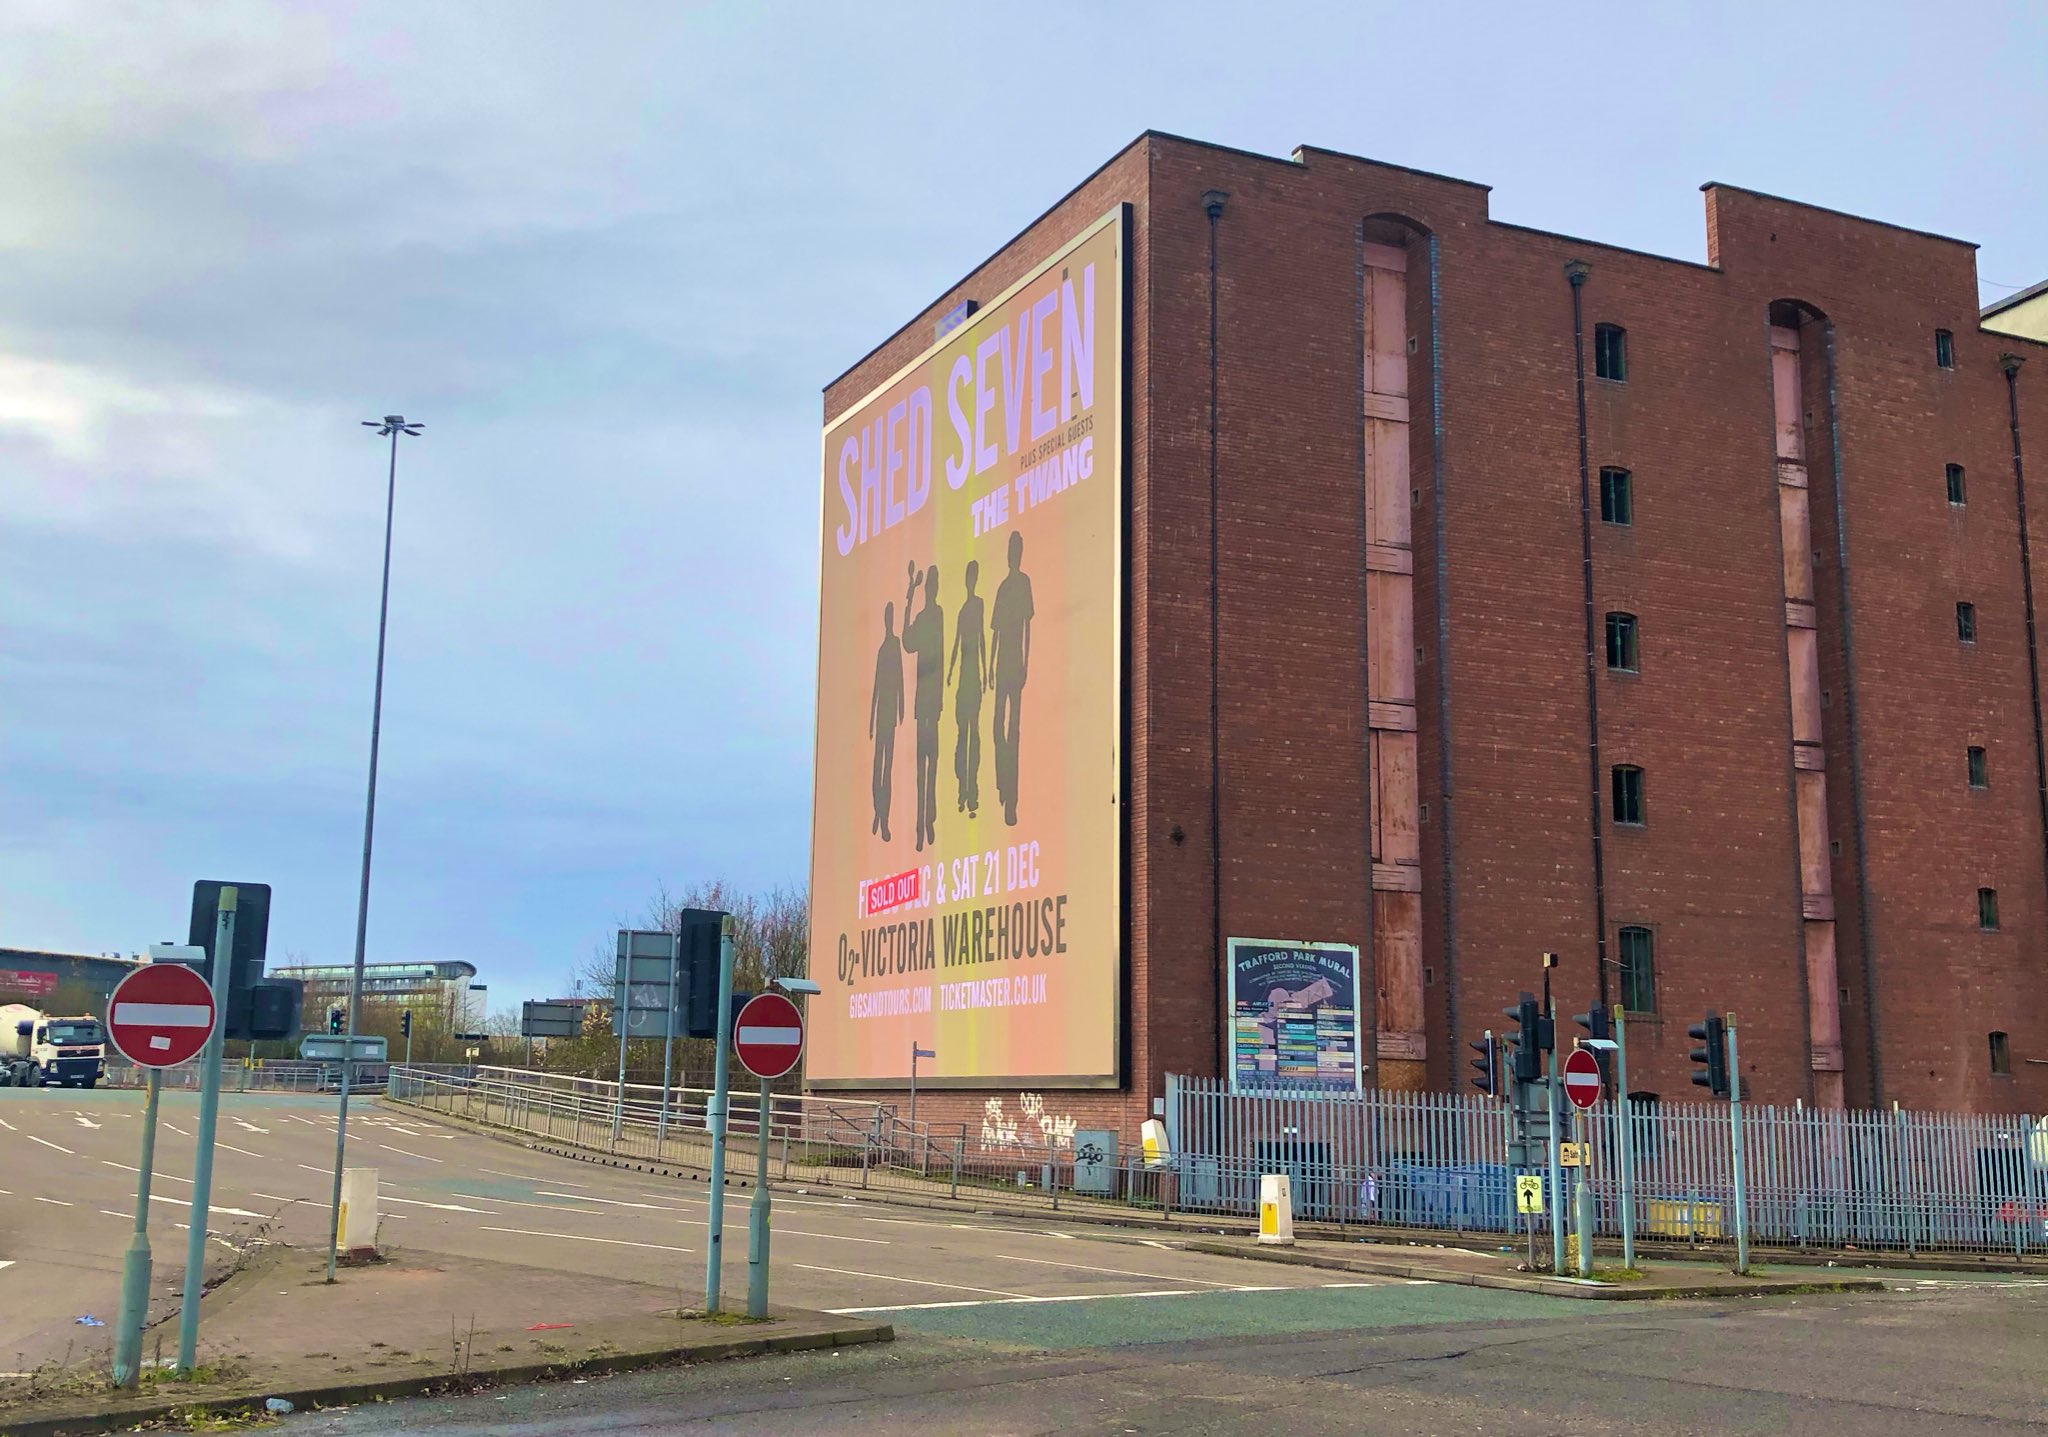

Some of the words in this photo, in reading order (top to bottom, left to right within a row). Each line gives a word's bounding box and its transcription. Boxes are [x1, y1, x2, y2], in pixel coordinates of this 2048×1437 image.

[836, 385, 932, 556] SHED
[945, 262, 1095, 490] SEVEN
[1020, 449, 1036, 470] PLUS
[1038, 432, 1065, 460] SPECIAL
[1067, 414, 1094, 442] GUESTS
[971, 484, 1008, 538] THE
[1015, 435, 1094, 514] TWANG
[871, 881, 895, 910] SOLD
[897, 874, 916, 901] OUT
[935, 862, 946, 905] &
[951, 855, 979, 901] SAT
[983, 849, 1000, 896] 21
[1007, 840, 1040, 892] DEC
[943, 895, 1067, 967] WAREHOUSE
[1238, 951, 1288, 972] TRAFFORD
[1292, 951, 1316, 963] PARK
[1318, 956, 1351, 978] MURAL
[1273, 962, 1295, 970] SECOND
[849, 986, 932, 1019] GIGSANDTOURS.COM
[940, 974, 1047, 1011] TICKETMASTER.CO.UK
